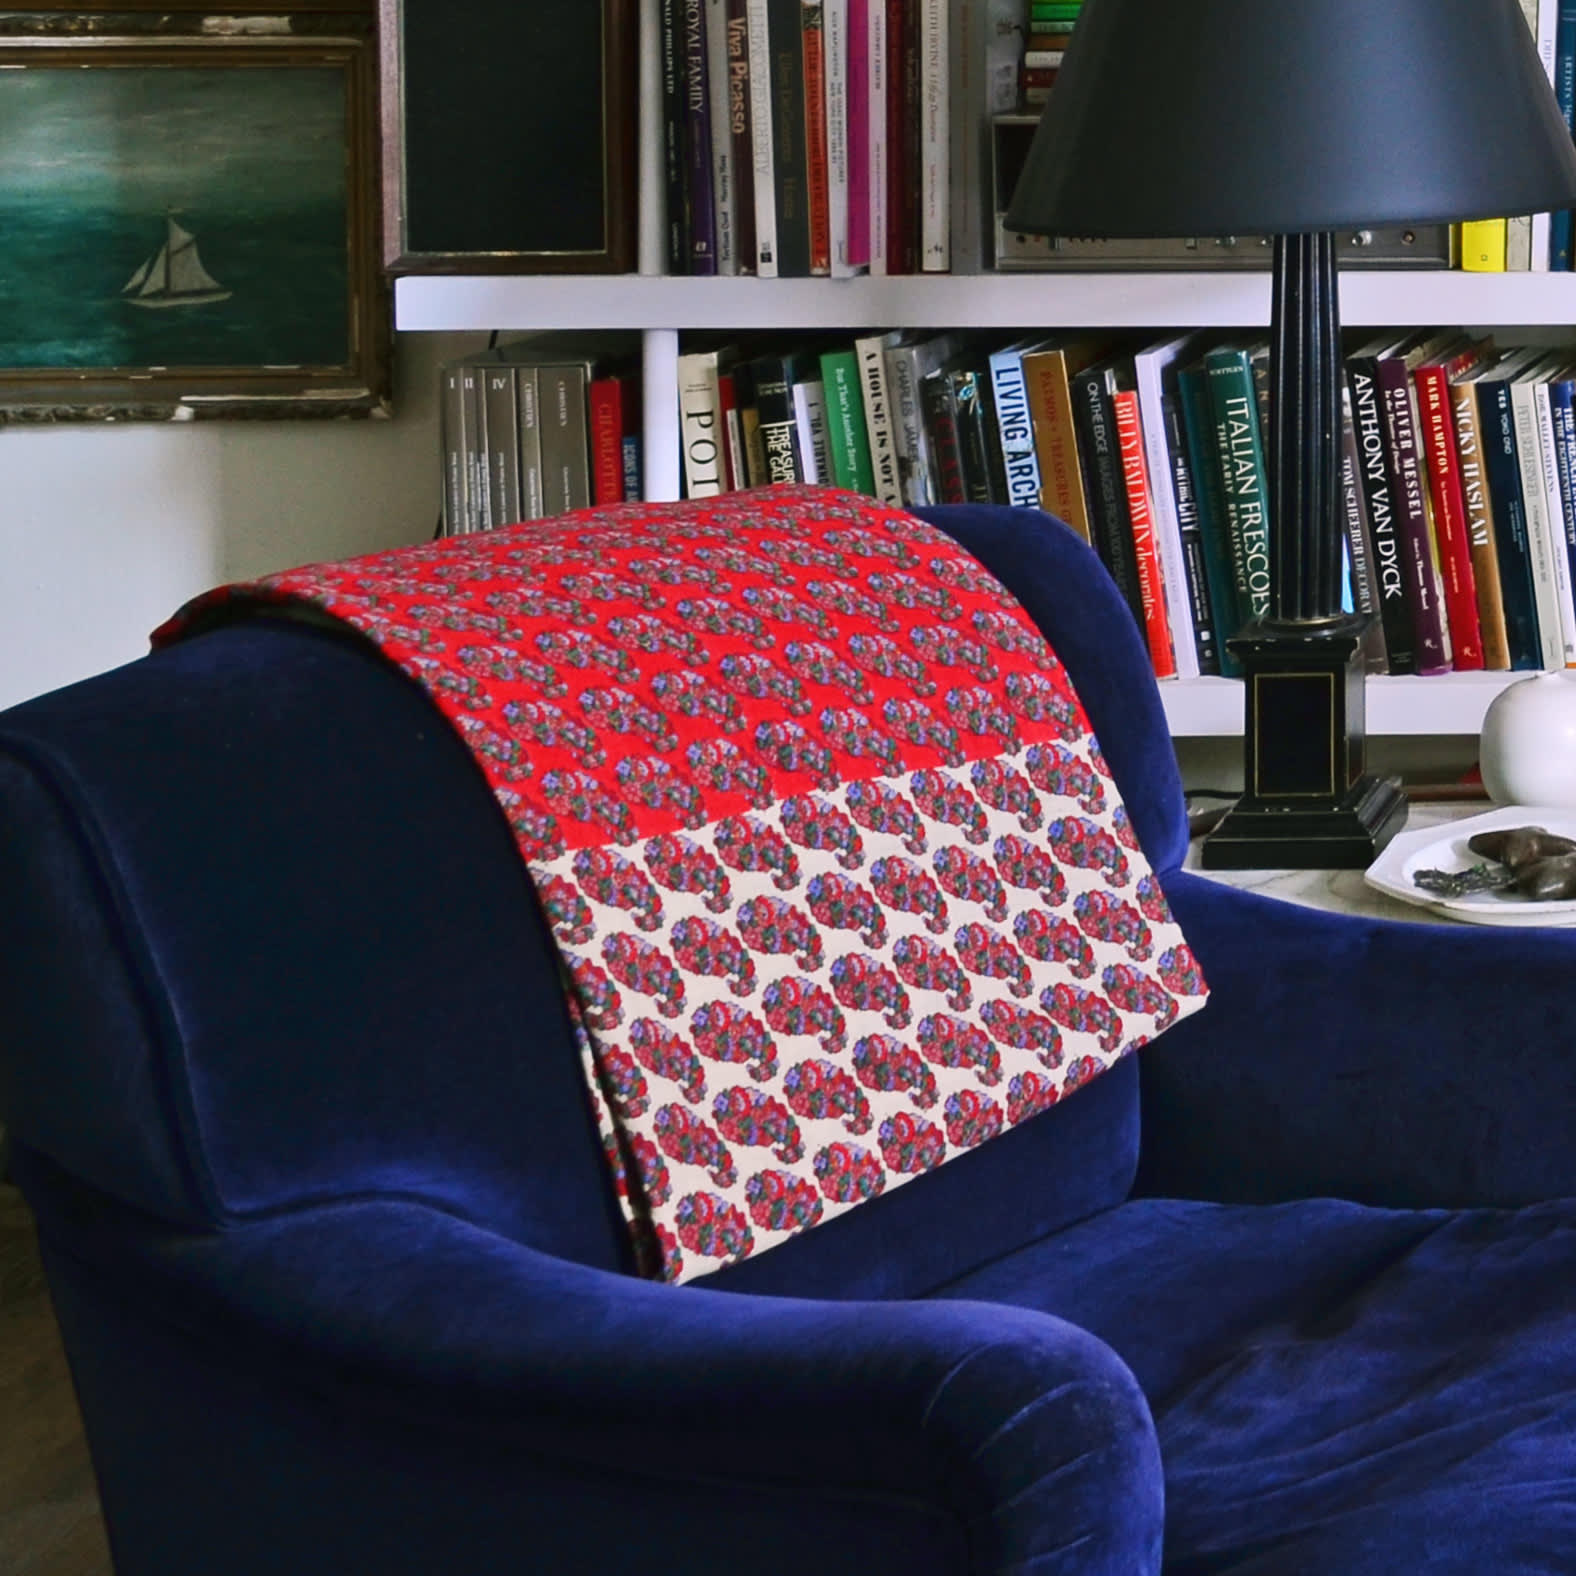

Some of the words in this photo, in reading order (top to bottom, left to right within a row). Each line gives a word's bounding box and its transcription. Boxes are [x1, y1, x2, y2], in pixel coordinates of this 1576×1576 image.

[728, 17, 745, 56] Viva
[688, 56, 702, 113] FAMILY
[730, 61, 747, 134] Picasso
[865, 351, 878, 361] A
[867, 368, 887, 425] HOUSE
[994, 368, 1026, 441] LIVING
[1392, 388, 1413, 449] OLIVER
[1427, 376, 1439, 410] MARK
[876, 431, 889, 447] IS
[1115, 401, 1138, 451] BILLY
[1353, 374, 1386, 483] ANTHONY
[1430, 415, 1449, 475] HAMPTON
[1453, 397, 1481, 458] NICKY
[879, 453, 893, 486] NOT
[1121, 455, 1150, 543] BALDWIN
[1402, 457, 1422, 519] MESSEL
[1225, 396, 1259, 495] ITALIAN
[1242, 503, 1270, 616] FRESCOES
[1371, 487, 1394, 534] VAN
[1464, 462, 1489, 546] HASLAM
[1380, 539, 1402, 599] DYCK
